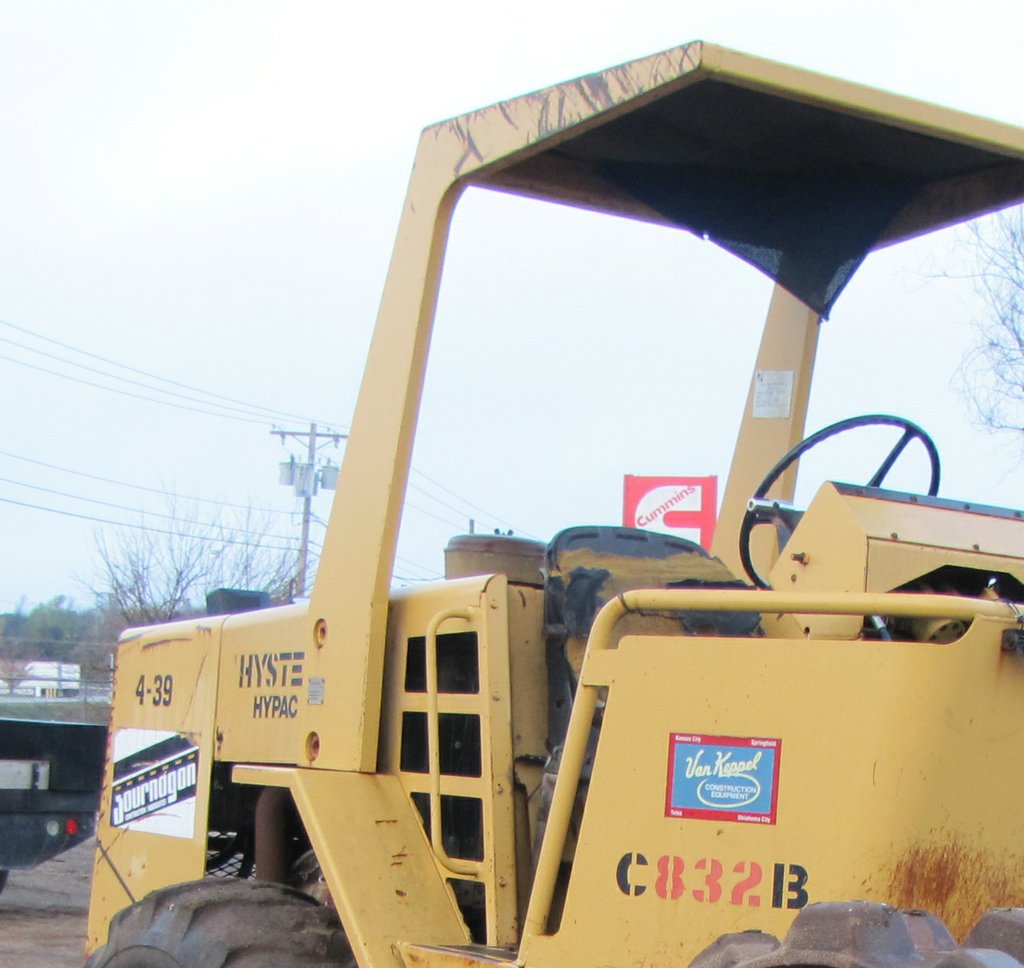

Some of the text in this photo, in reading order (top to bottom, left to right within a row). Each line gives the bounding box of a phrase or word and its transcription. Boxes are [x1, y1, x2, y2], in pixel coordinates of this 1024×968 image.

[637, 486, 696, 527] Cummins
[239, 652, 305, 688] HYSTE
[135, 674, 174, 706] 4-39
[253, 695, 298, 719] HYPAC
[685, 749, 762, 778] Van Keppel
[704, 783, 757, 794] CONSTRUCTION
[711, 791, 749, 800] EQUIPMENT
[616, 852, 809, 909] C832B
